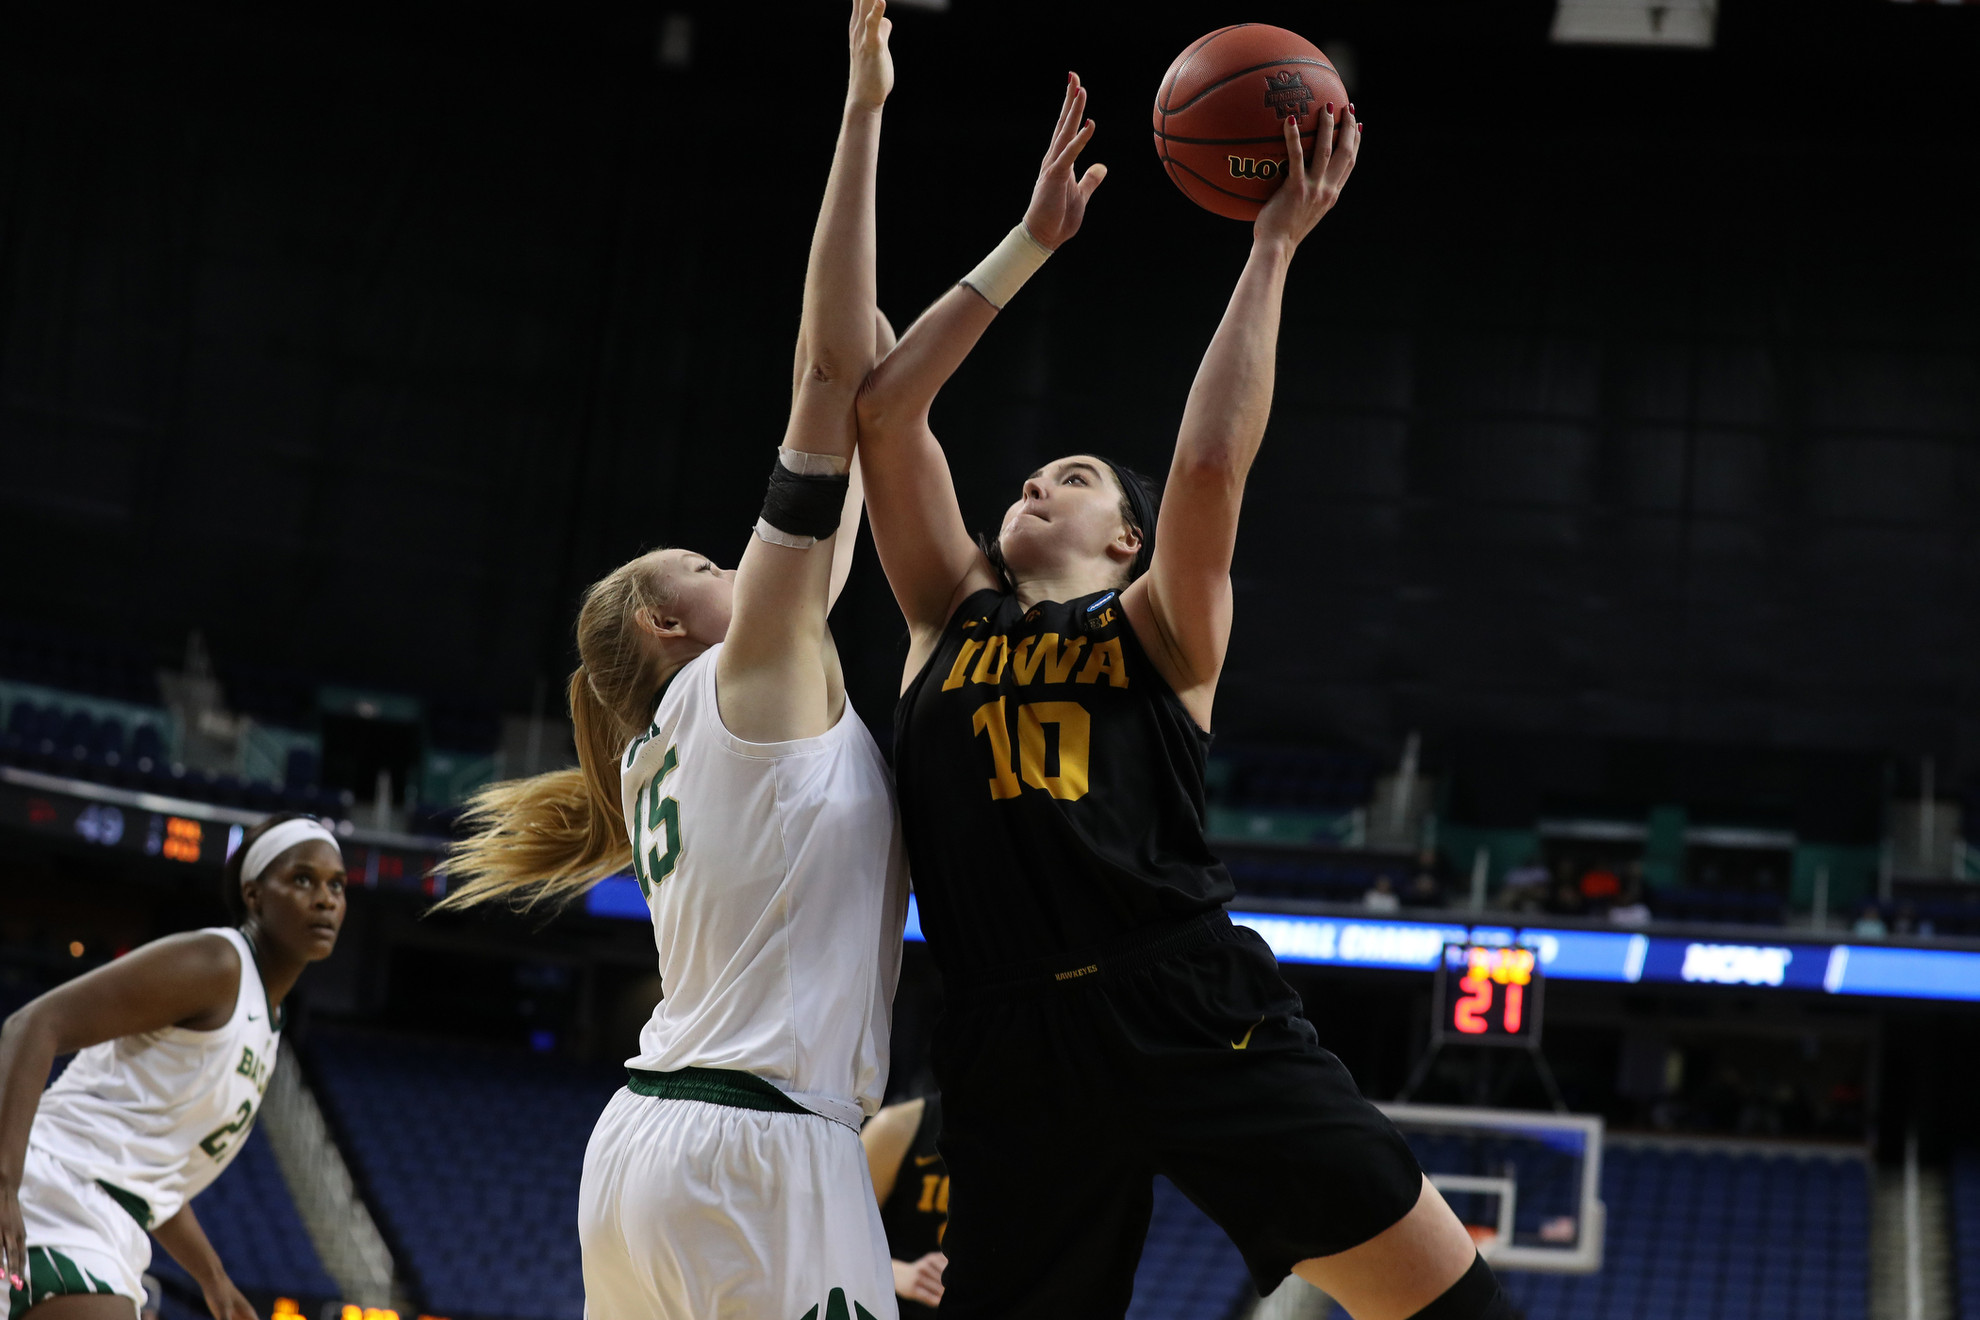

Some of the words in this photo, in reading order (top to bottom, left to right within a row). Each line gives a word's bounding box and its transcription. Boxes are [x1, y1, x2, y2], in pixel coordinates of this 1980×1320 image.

[941, 632, 1130, 692] IOWA
[972, 695, 1091, 801] 10
[1055, 964, 1098, 981] HAWKEYES
[1454, 976, 1523, 1034] 21
